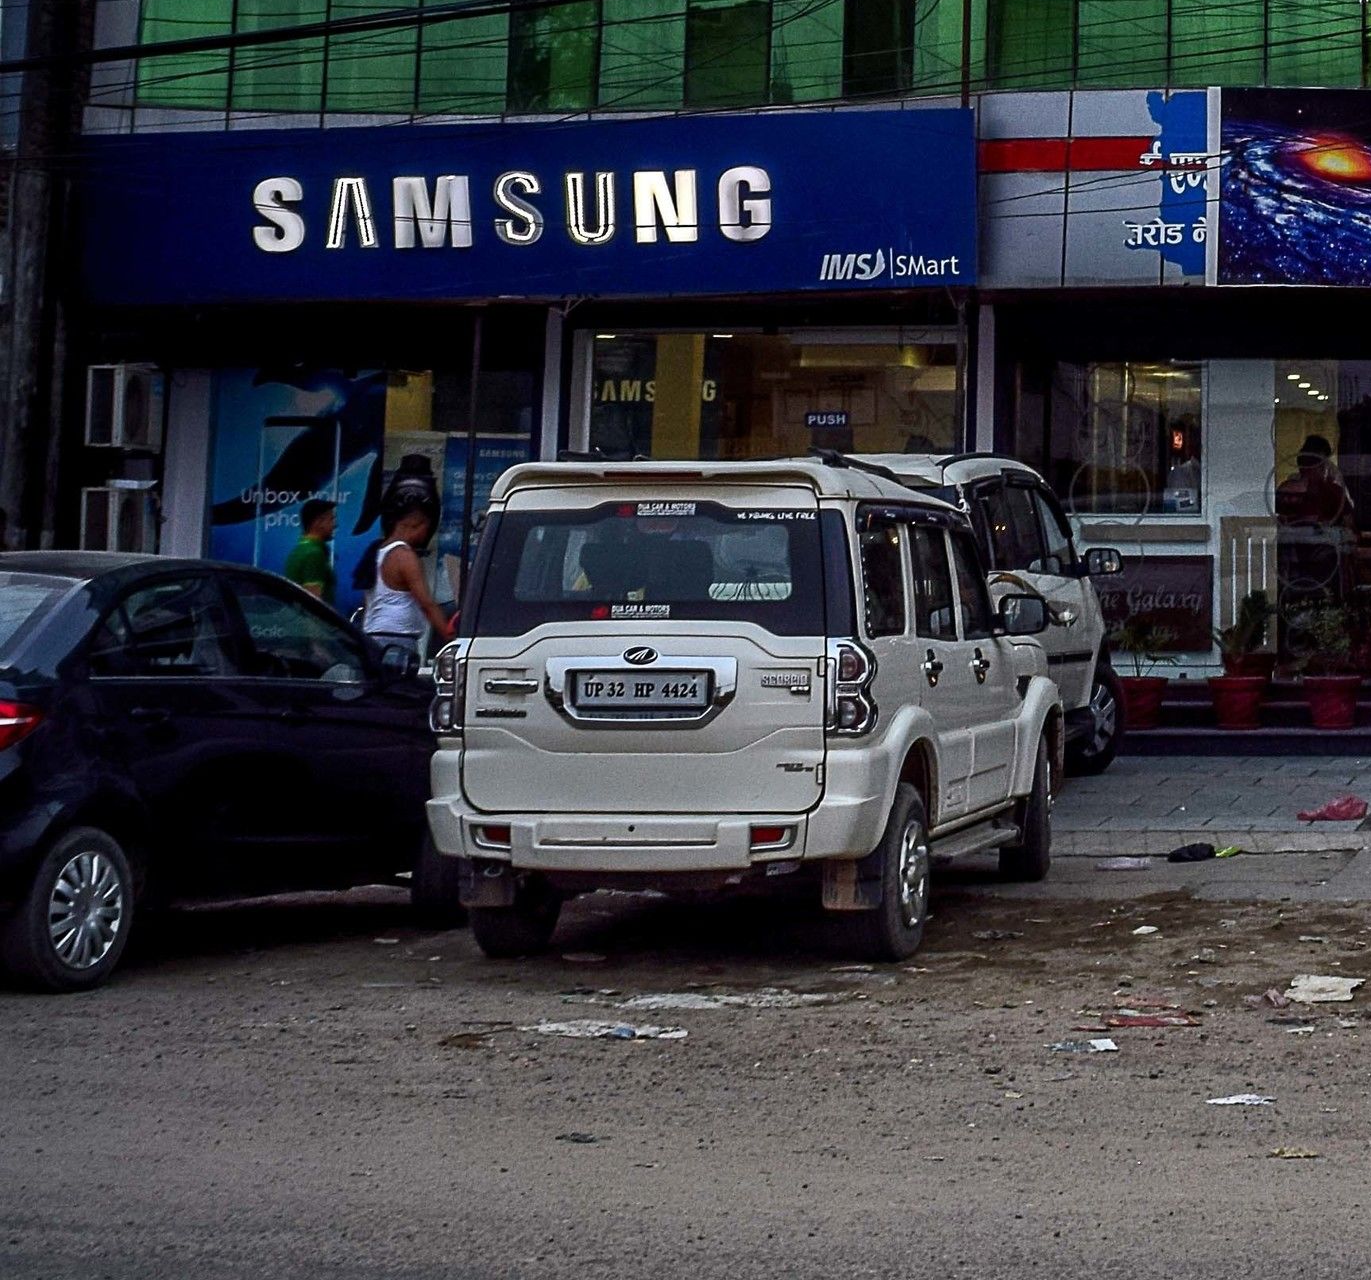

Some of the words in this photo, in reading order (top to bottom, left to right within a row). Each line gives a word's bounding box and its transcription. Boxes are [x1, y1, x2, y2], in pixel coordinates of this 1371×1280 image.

[253, 165, 773, 253] SAMSUNG
[819, 252, 881, 281] IMS
[895, 254, 961, 277] SMart
[807, 413, 847, 426] PUSH
[240, 487, 301, 505] Unbox
[584, 681, 605, 698] UP
[606, 681, 626, 697] 32
[634, 682, 655, 698] HP
[661, 682, 699, 699] 4424
